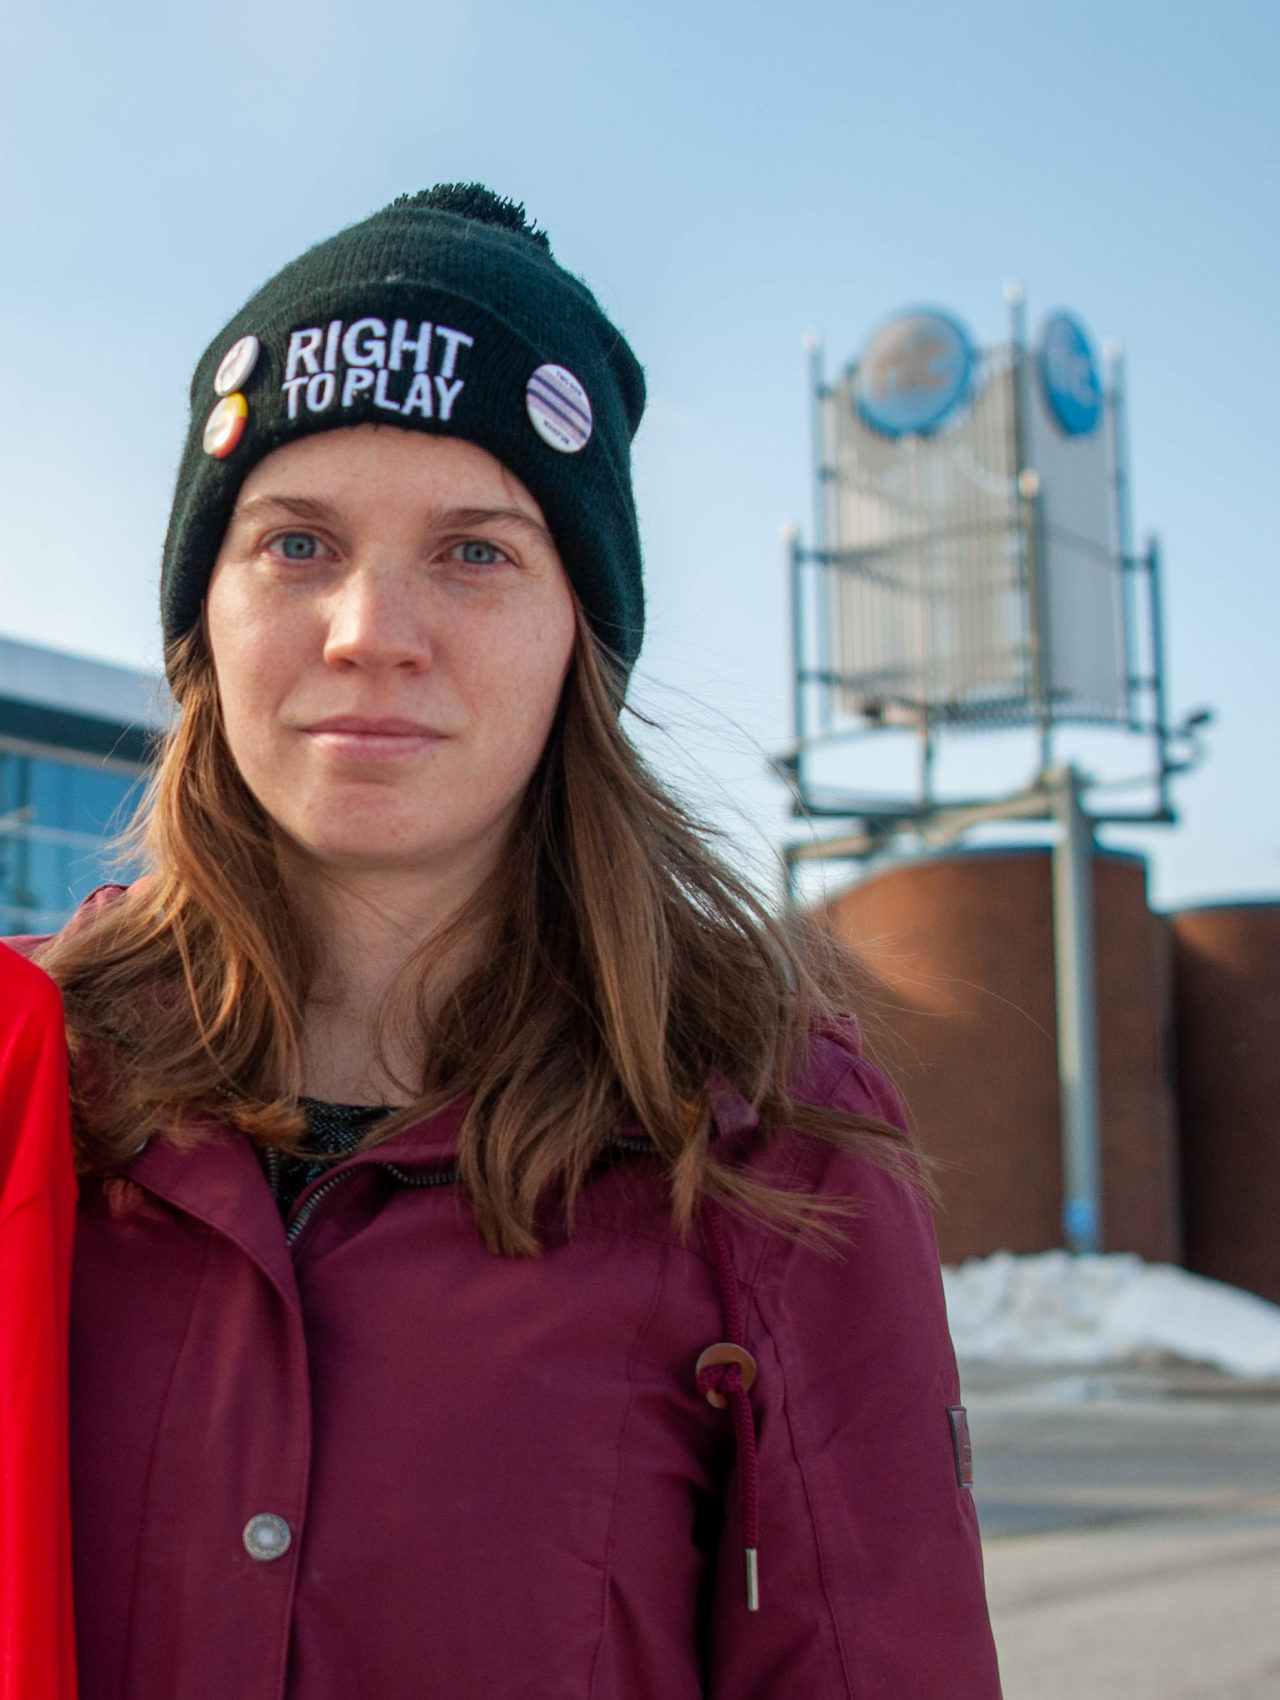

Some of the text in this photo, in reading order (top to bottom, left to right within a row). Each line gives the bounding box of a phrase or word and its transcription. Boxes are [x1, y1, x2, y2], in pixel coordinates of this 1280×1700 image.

[285, 317, 474, 380] RIGHT
[281, 367, 465, 421] TO PLAY
